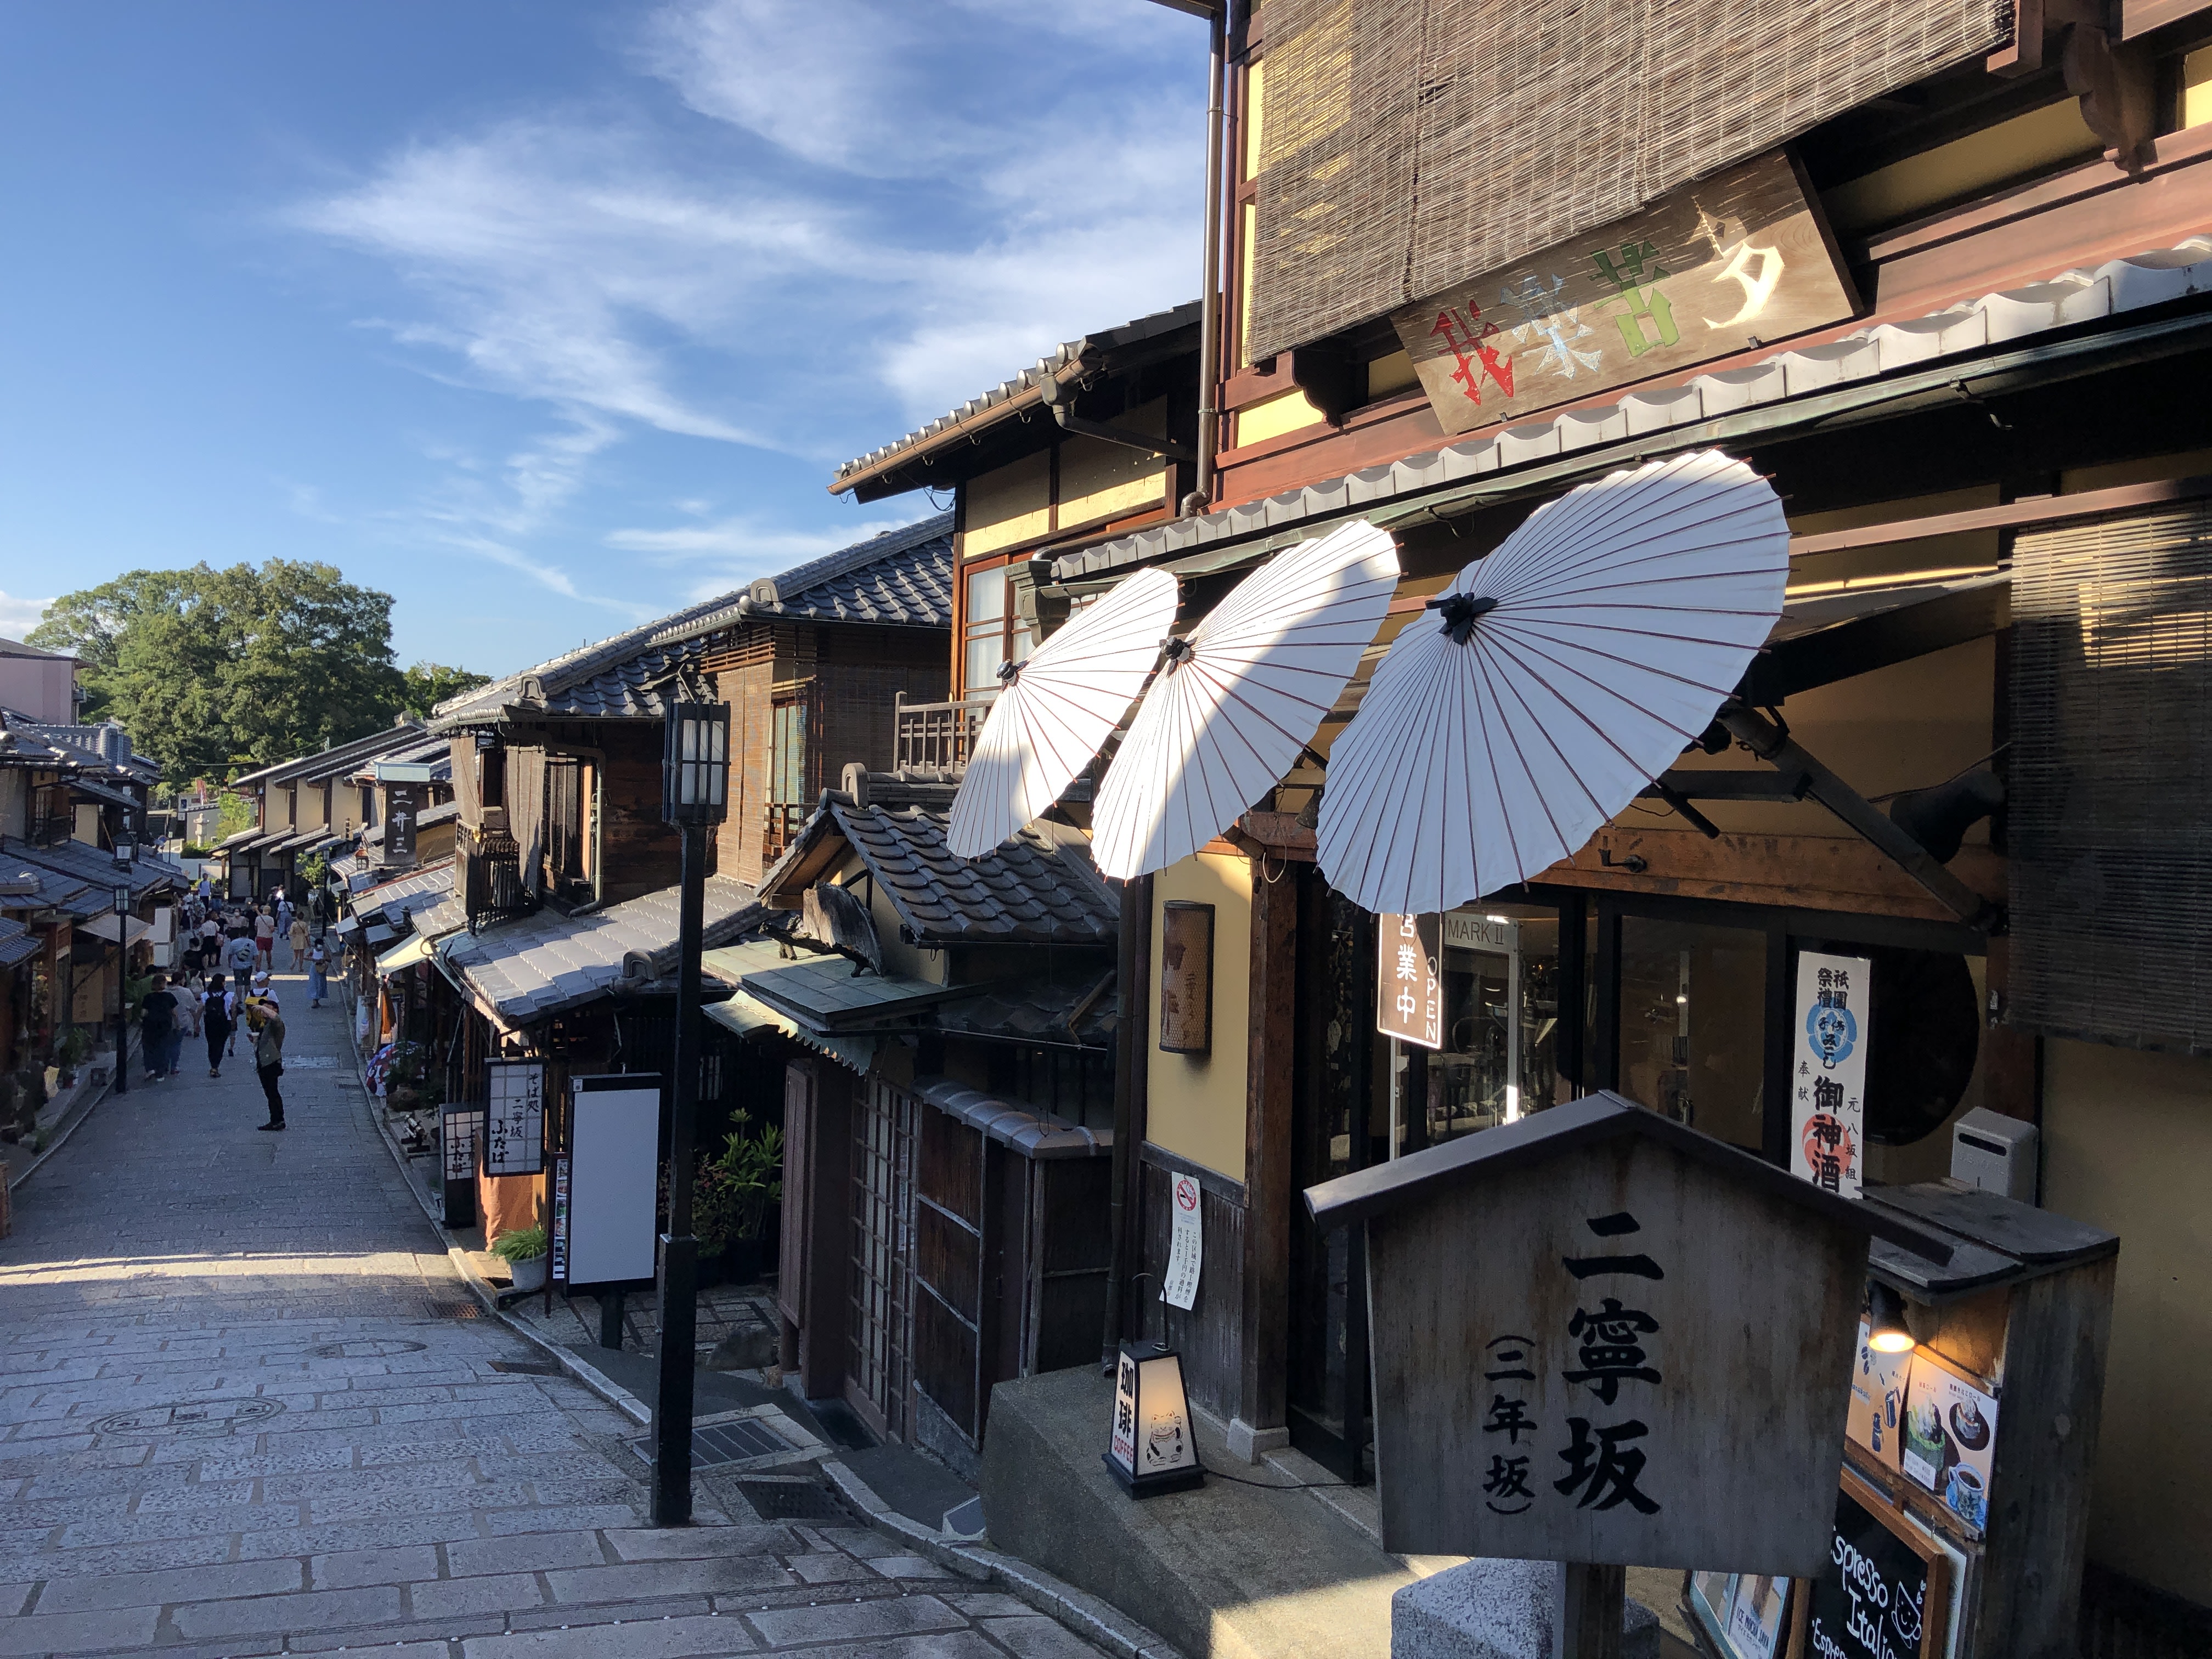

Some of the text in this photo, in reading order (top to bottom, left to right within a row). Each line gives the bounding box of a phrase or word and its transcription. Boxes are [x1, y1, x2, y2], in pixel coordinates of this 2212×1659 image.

[392, 789, 413, 854] 二井三
[1448, 918, 1491, 944] MARK
[1395, 913, 1418, 1025] 営業中
[1833, 969, 1849, 1011] 祇園
[1426, 956, 1437, 1041] OPEN
[526, 1072, 540, 1113] そば処
[1797, 1059, 1810, 1102] 奉献
[491, 1119, 510, 1164] ふたば
[510, 1098, 523, 1138] 二寧坂
[1812, 1074, 1844, 1193] 御神酒
[1844, 1097, 1861, 1181] 元八坂組
[1554, 1211, 1664, 1515] 二寧坂
[1119, 1361, 1134, 1438] 珈琲
[1114, 1435, 1133, 1464] COFFEE
[1830, 1527, 1889, 1609] spresso
[1736, 1606, 1745, 1624] ICE
